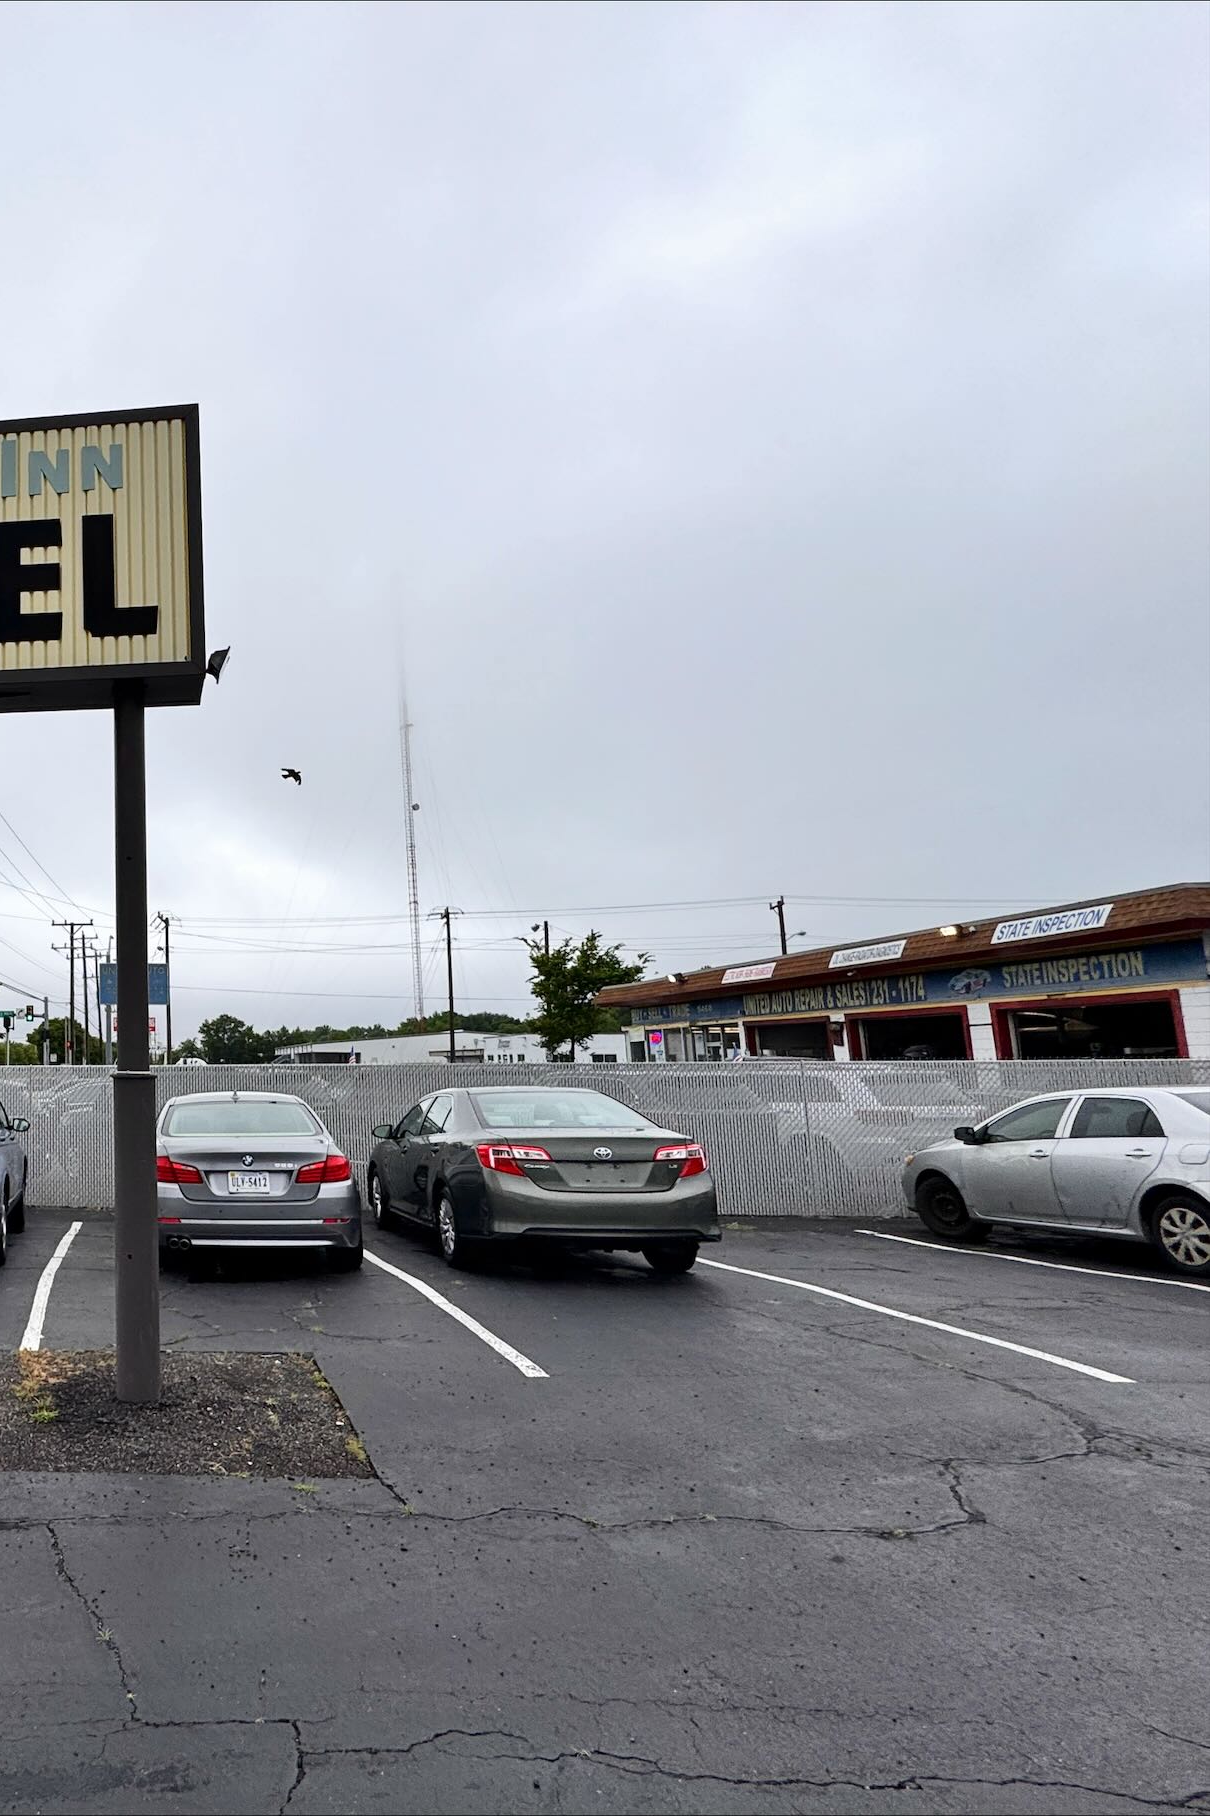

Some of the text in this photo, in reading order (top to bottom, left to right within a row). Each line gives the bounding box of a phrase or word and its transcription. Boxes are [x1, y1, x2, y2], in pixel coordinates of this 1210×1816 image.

[1, 439, 124, 498] INN
[996, 907, 1106, 941] STATE INSPECTION
[1002, 951, 1145, 988] STATE INSPECTION
[743, 993, 770, 1015] UNITED
[771, 991, 793, 1013] AUTO
[794, 987, 825, 1011] REPAIR
[826, 984, 835, 1009] &
[835, 981, 866, 1008] SALES
